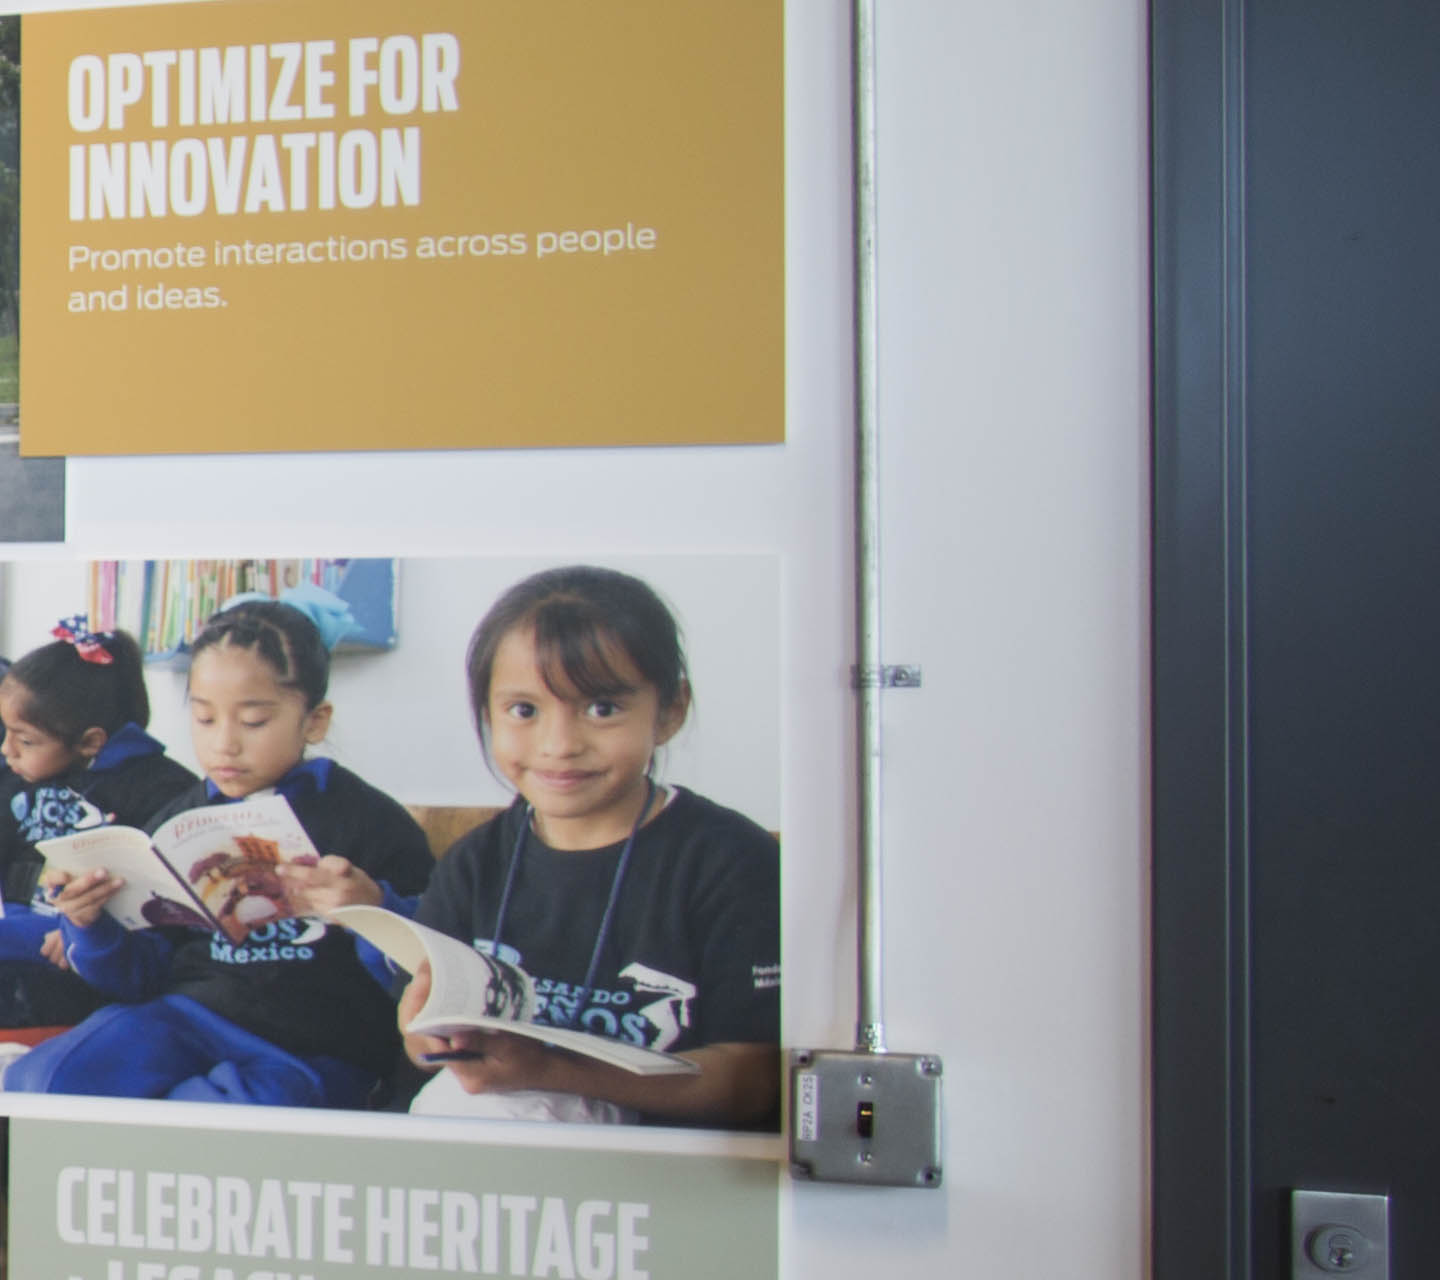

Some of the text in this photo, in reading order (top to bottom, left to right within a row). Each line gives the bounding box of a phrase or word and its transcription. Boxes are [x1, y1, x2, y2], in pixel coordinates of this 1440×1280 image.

[67, 32, 459, 133] OPTIMIZE FOR
[68, 126, 420, 222] INNOVATION
[68, 222, 656, 272] Promote interactions across people
[67, 282, 227, 313] and ideas.
[56, 1165, 355, 1264] CELEBRATE
